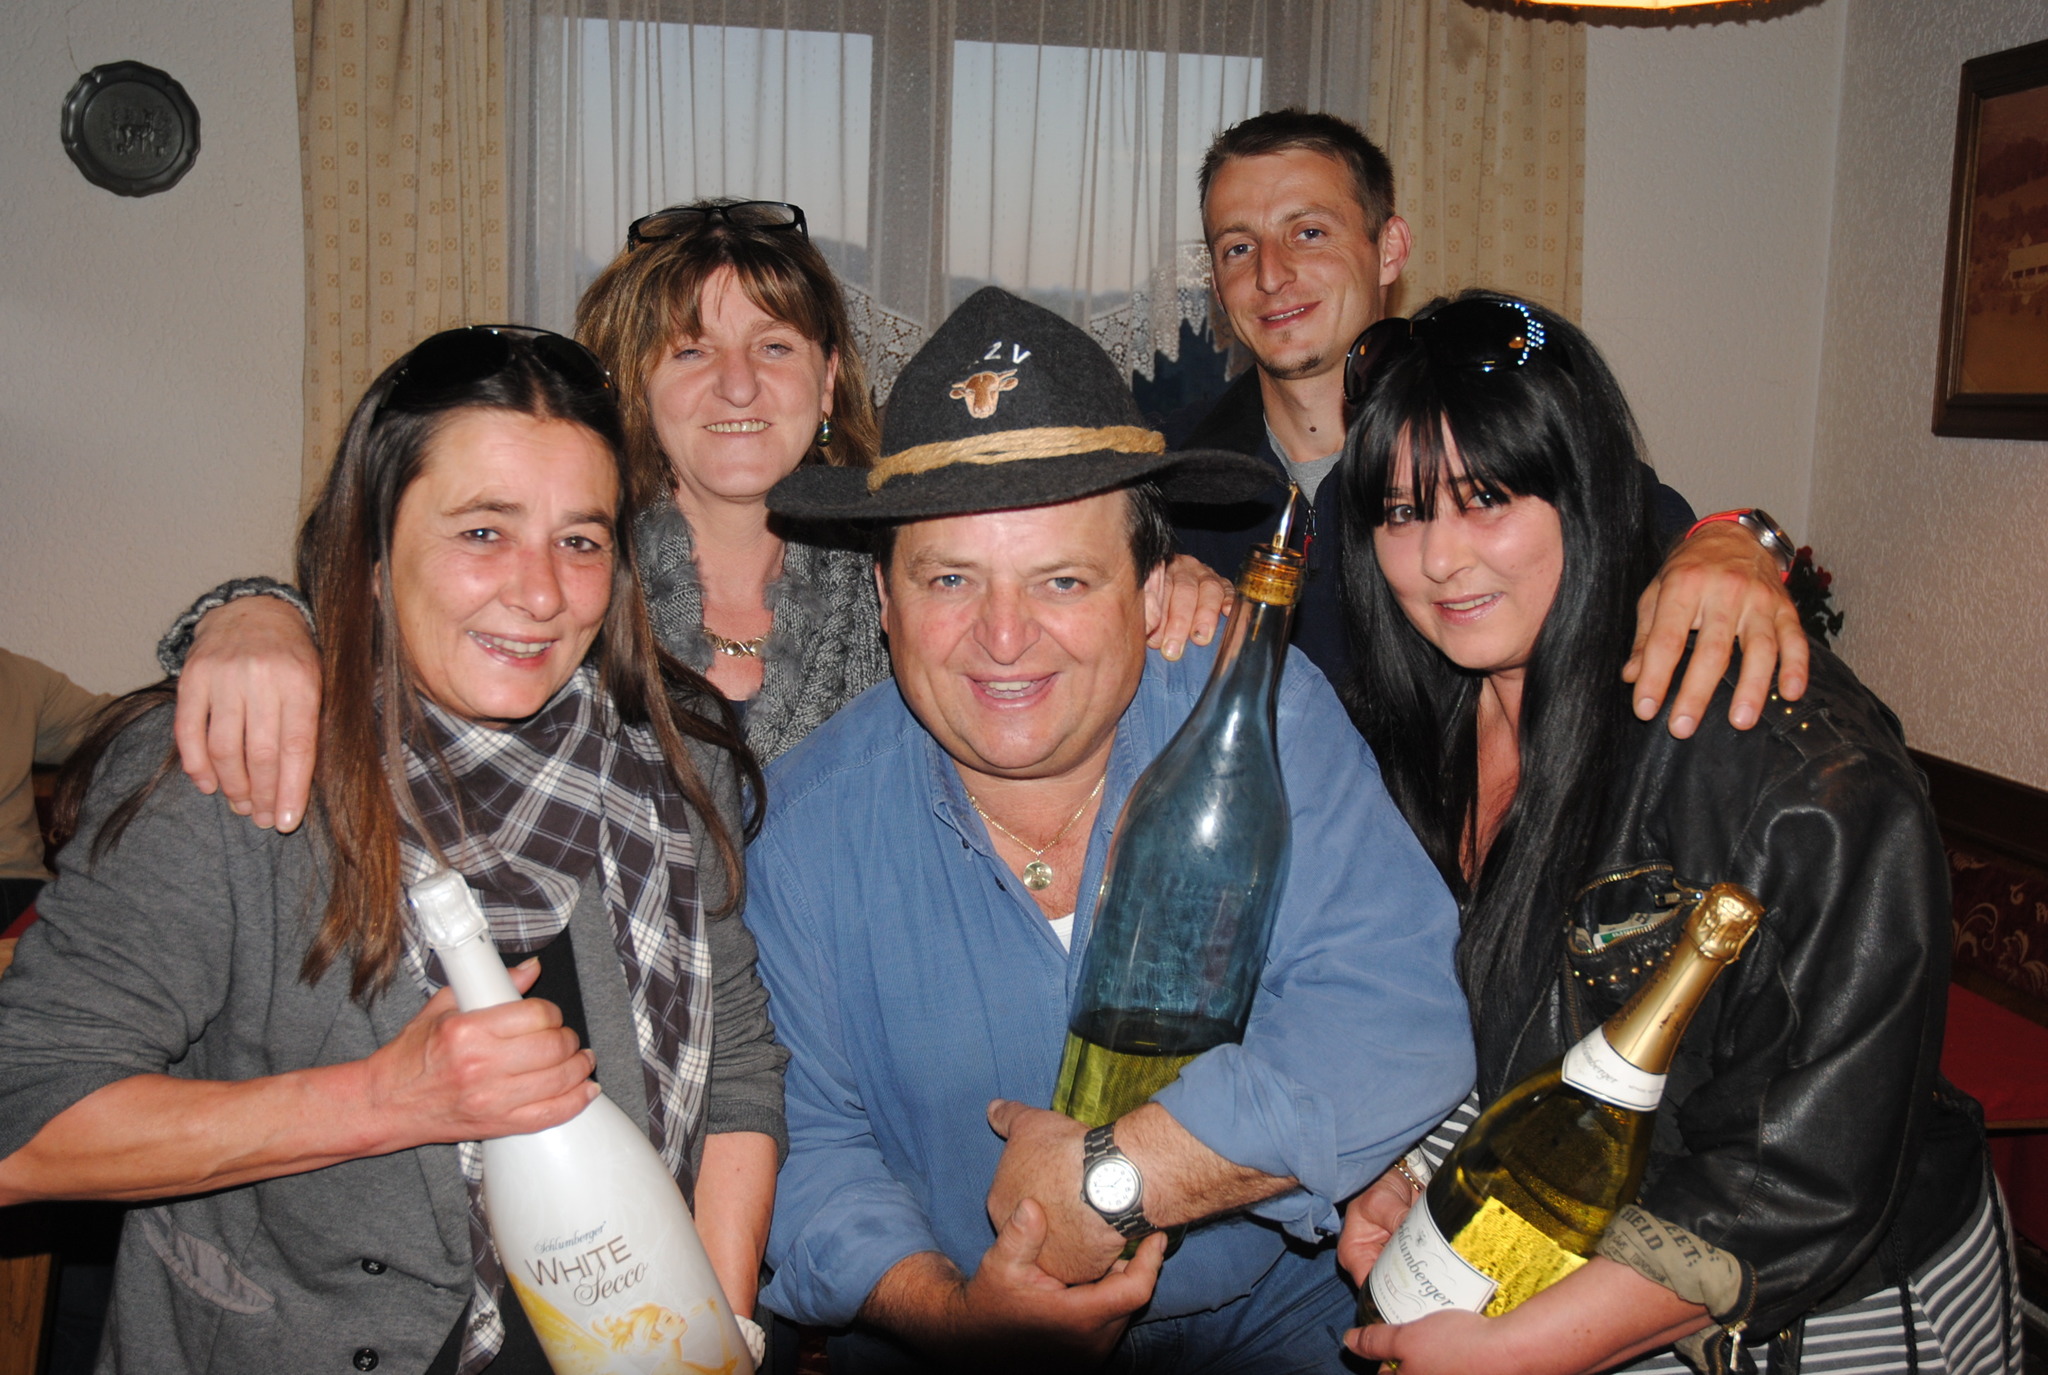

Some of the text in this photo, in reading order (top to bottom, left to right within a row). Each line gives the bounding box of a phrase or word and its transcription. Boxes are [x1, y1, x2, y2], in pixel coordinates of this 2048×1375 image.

[535, 1221, 606, 1254] Schlumberger
[1621, 1207, 1664, 1251] FIELD
[525, 1235, 632, 1286] WHITE
[574, 1262, 648, 1306] Secco
